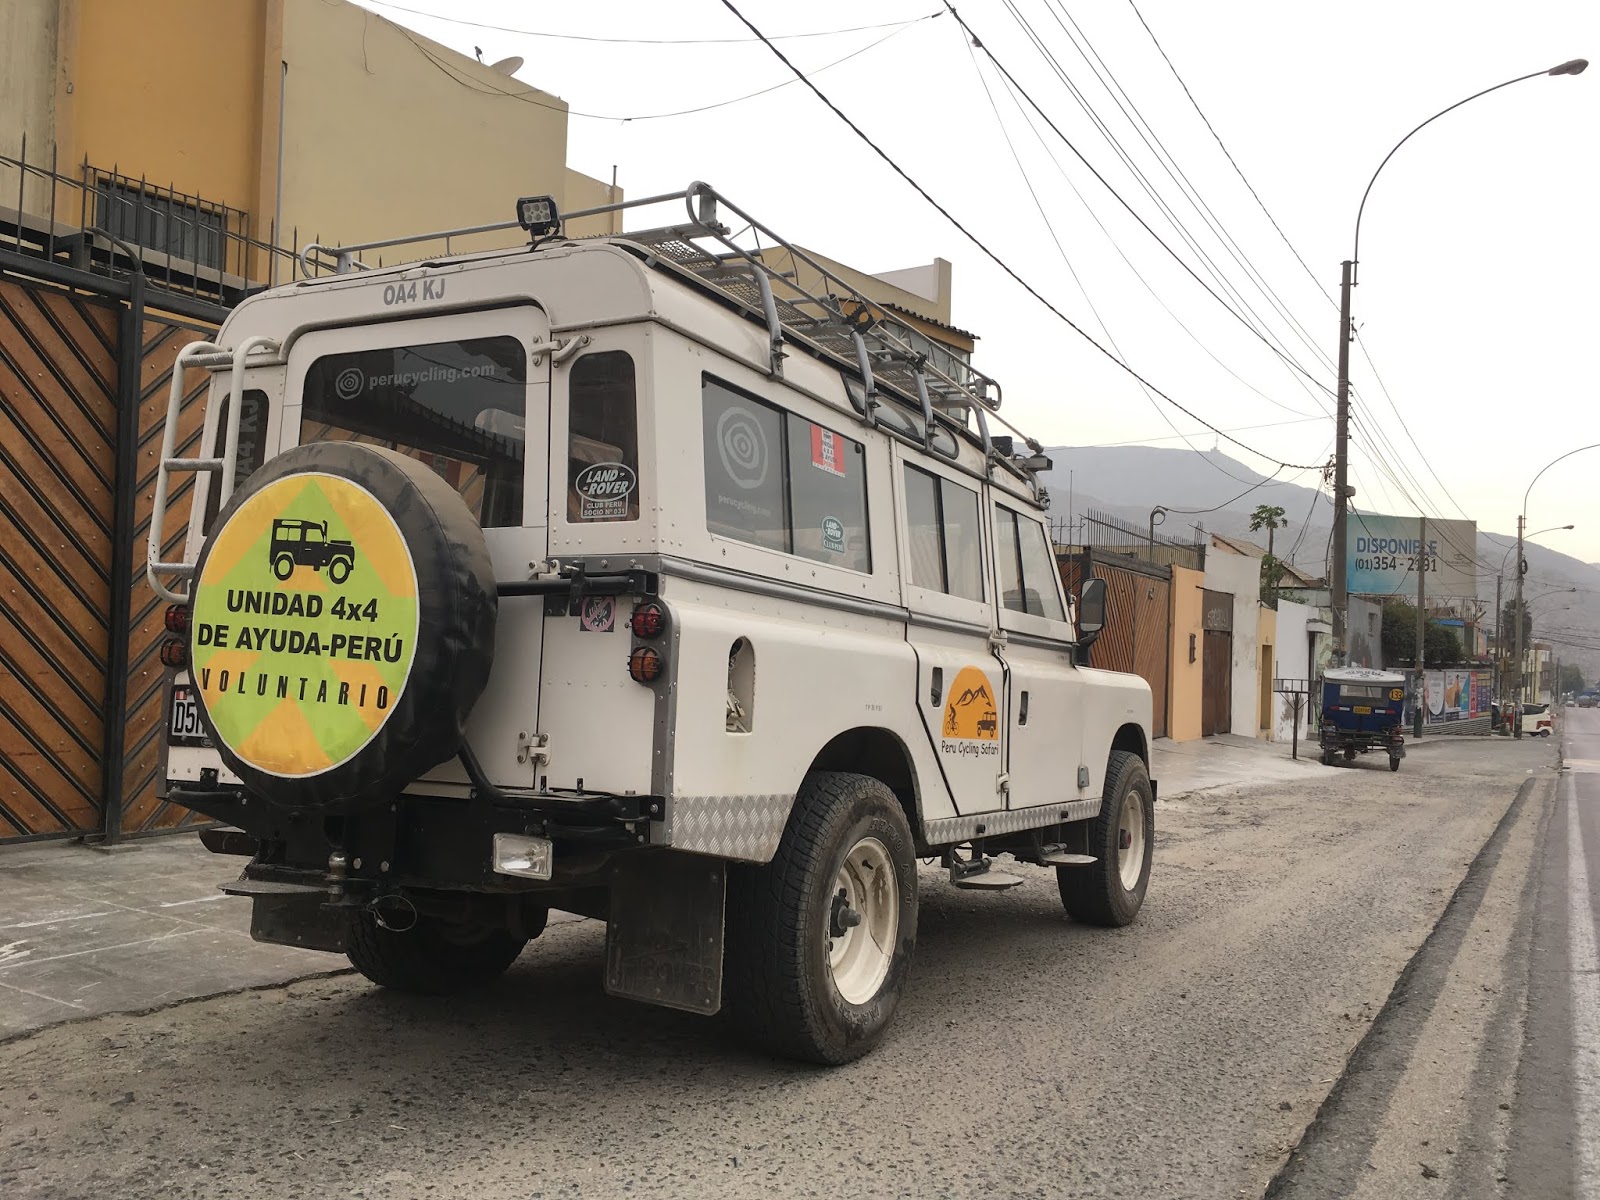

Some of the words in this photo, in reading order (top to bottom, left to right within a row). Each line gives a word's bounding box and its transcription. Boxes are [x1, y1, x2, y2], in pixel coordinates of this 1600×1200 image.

[383, 281, 417, 305] OA4
[423, 278, 446, 300] KJ
[369, 364, 495, 390] perucycling.com
[235, 440, 256, 484] A4
[586, 470, 619, 483] LAND
[588, 481, 629, 495] ROVER
[227, 589, 323, 618] UNIDAD
[330, 595, 378, 623] 4x4
[198, 623, 229, 648] DE
[235, 626, 403, 663] AYUDA-PERÚ
[201, 668, 388, 710] VOLUNTARIO
[941, 740, 957, 754] Peru
[958, 741, 980, 758] Cycling
[980, 742, 999, 755] Safari
